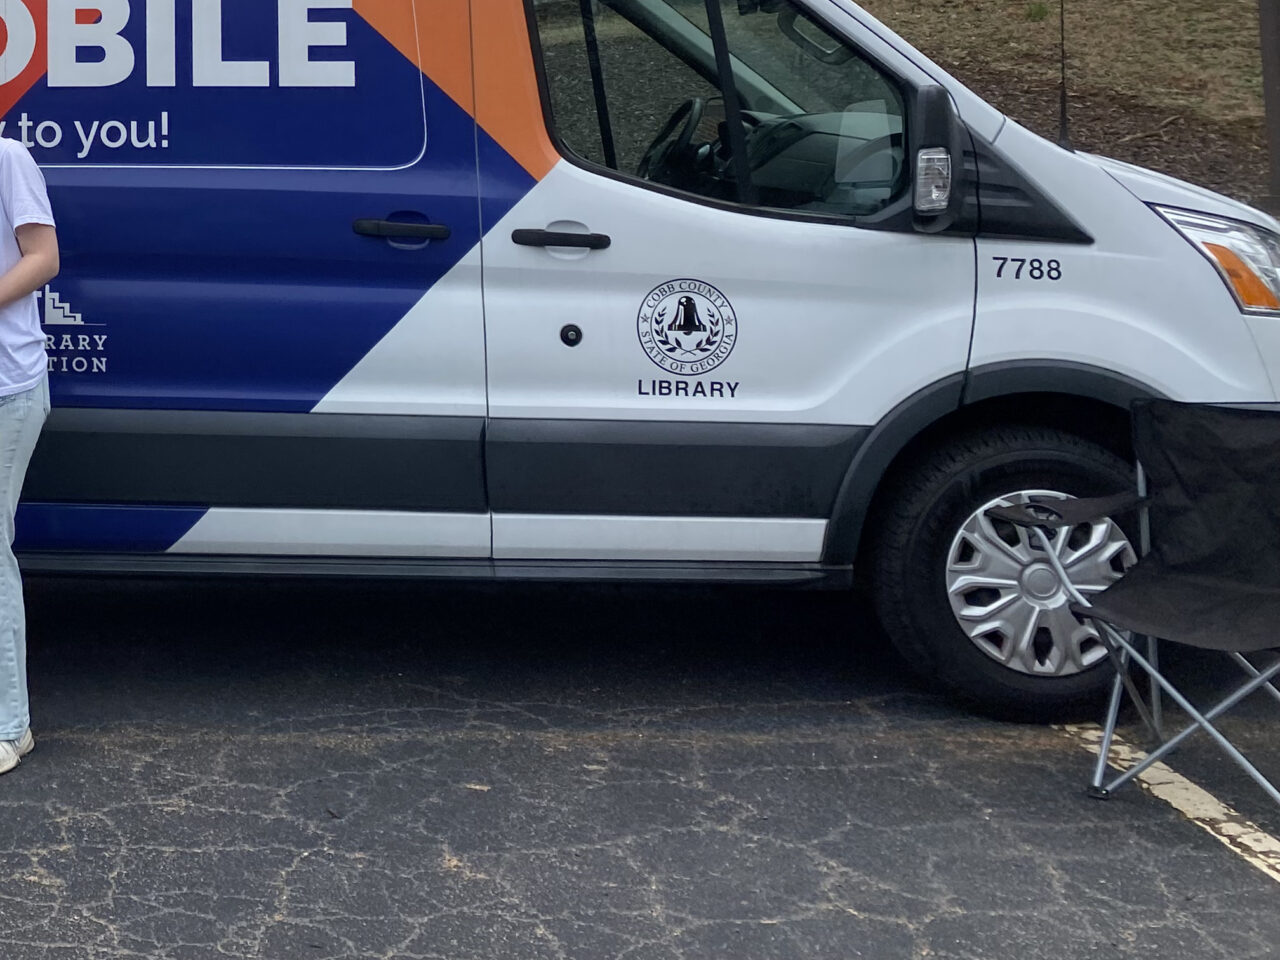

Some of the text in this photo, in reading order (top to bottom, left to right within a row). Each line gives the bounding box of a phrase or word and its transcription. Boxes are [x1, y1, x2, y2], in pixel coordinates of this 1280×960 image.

[18, 113, 62, 148] to
[74, 111, 169, 158] you!
[993, 257, 1062, 280] 7788
[646, 281, 728, 309] COBB COUNTY
[642, 331, 734, 373] STATE OF GEORGIA
[638, 379, 740, 398] LIBRARY
